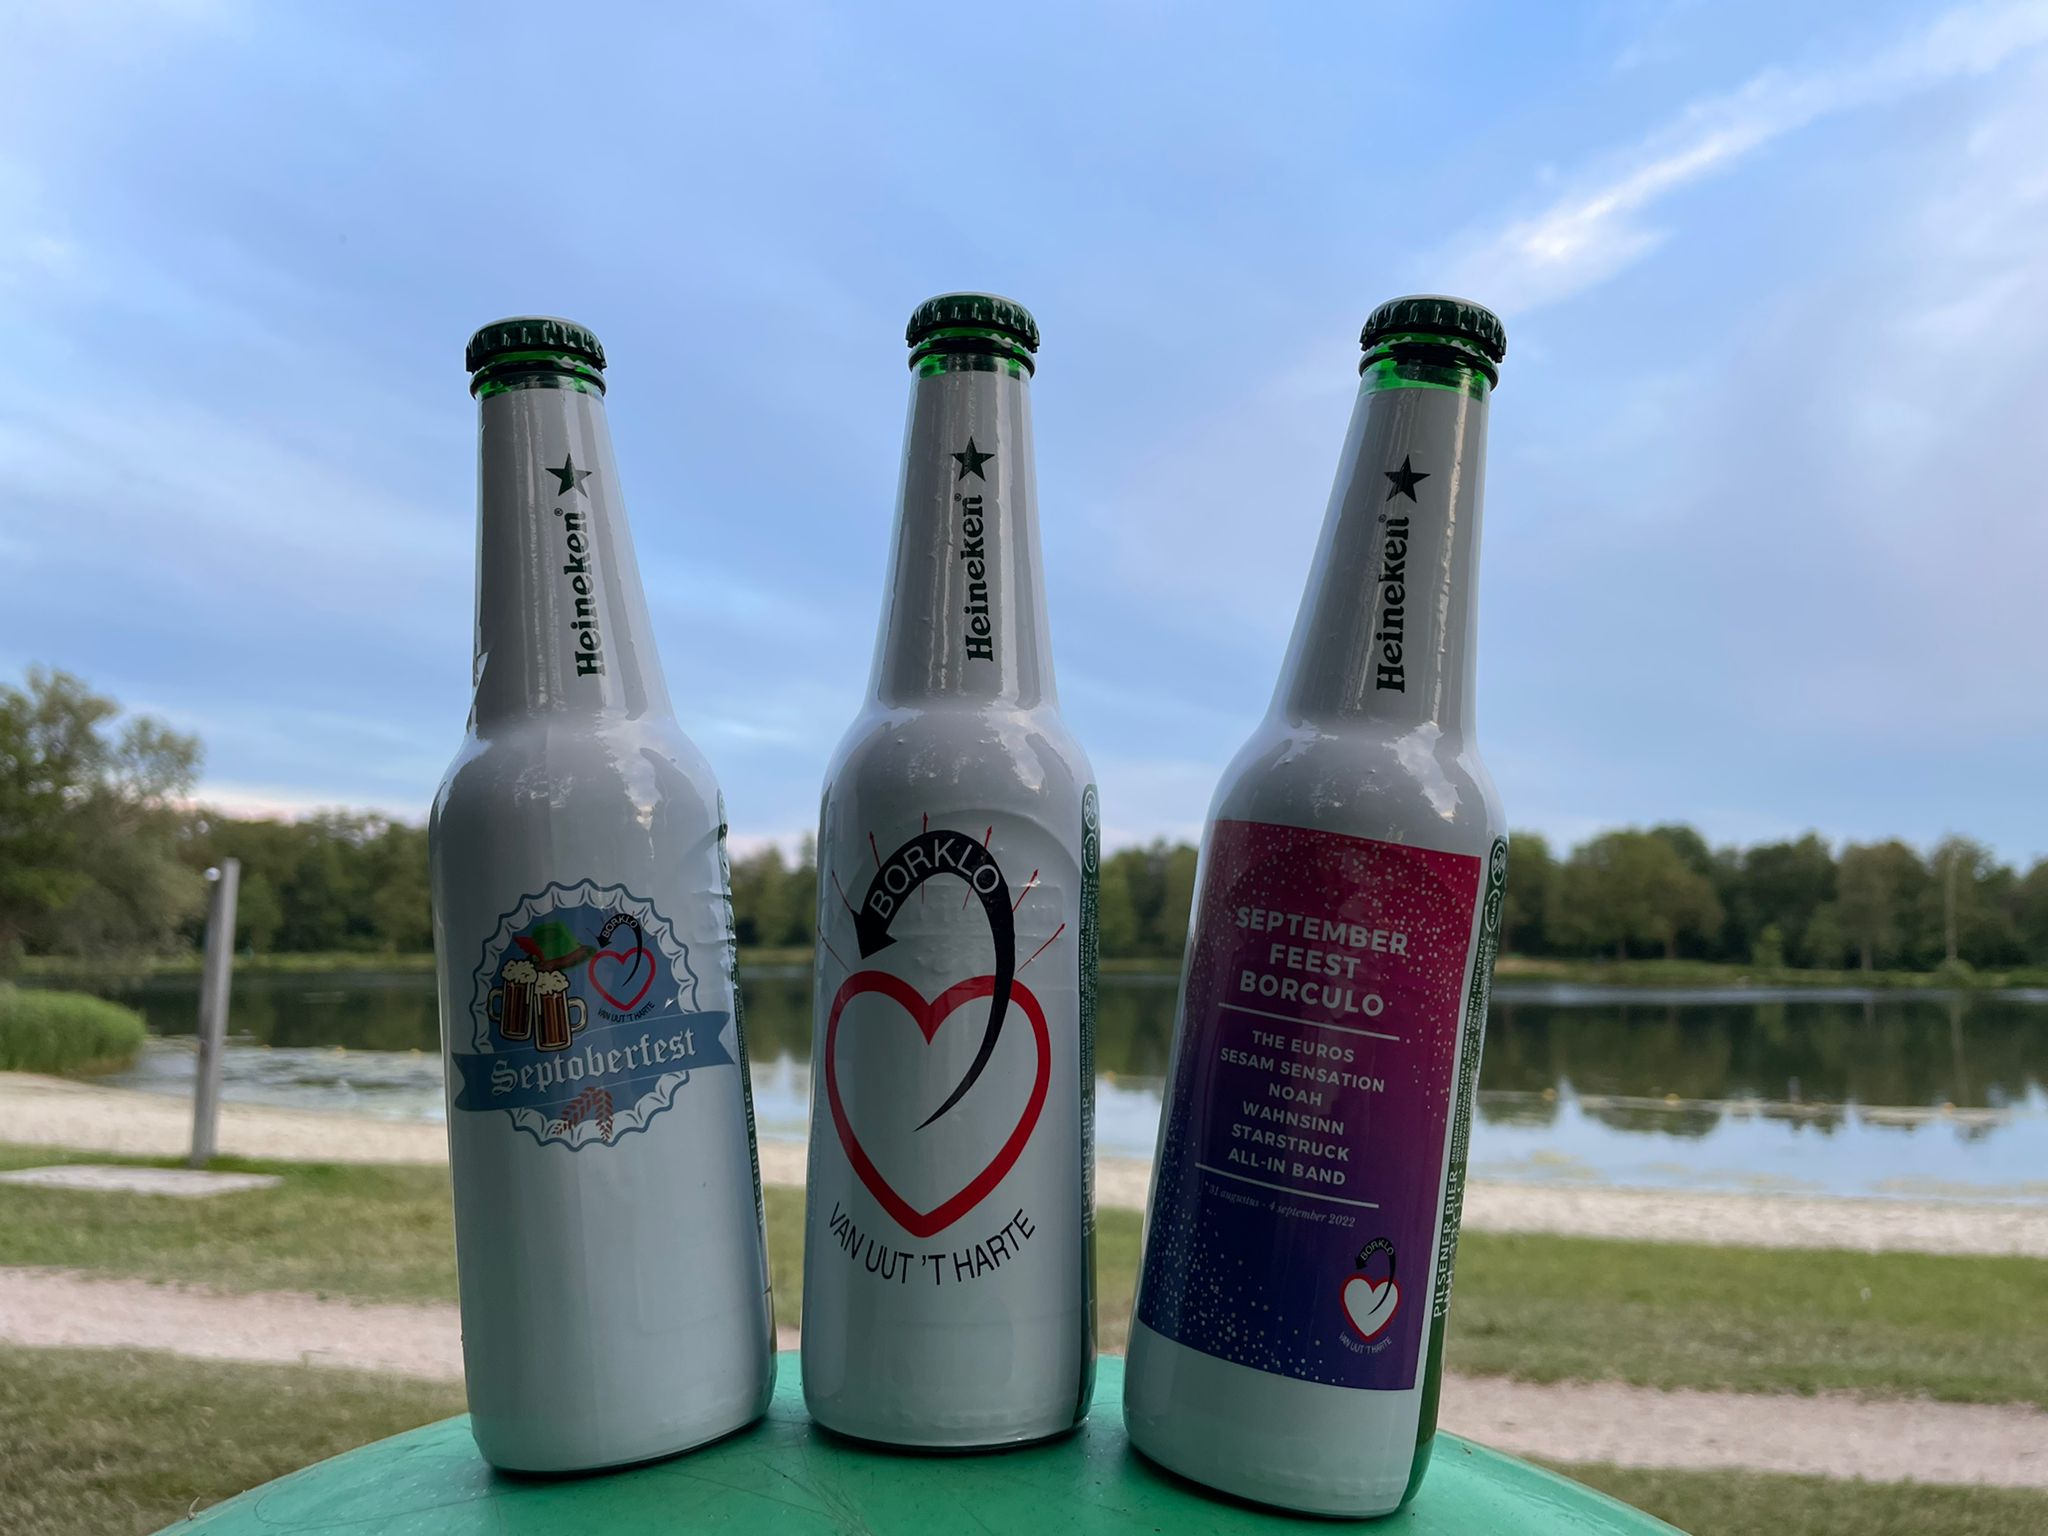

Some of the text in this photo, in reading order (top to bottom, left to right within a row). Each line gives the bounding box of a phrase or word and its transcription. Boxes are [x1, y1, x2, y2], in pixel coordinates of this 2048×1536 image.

[563, 510, 606, 677] Heineken
[960, 495, 994, 662] Heineken
[1376, 516, 1410, 693] Heineken
[870, 838, 999, 920] BORKLO
[602, 915, 638, 938] BORKLO
[1235, 906, 1409, 956] SEPTEMBER
[1269, 943, 1361, 979] FEEST
[598, 1008, 610, 1020] VAN
[611, 1014, 625, 1023] UUT
[635, 1001, 655, 1020] HARTE
[1240, 970, 1384, 1016] BORCULO
[491, 1028, 697, 1096] Septoberfest
[1252, 1030, 1355, 1063] THE EUROS
[1220, 1048, 1385, 1093] SESAM SENSATION
[1268, 1083, 1322, 1107] NOAH
[1243, 1101, 1345, 1136] WAHNSINN
[1231, 1123, 1350, 1162] STARSTRUCK
[1228, 1148, 1346, 1185] ALL-IN BAND
[1269, 1201, 1276, 1211] 4
[1277, 1206, 1327, 1223] september
[1328, 1214, 1356, 1228] 2022
[829, 1201, 1036, 1285] VAN UUT 'T HARTE
[1360, 1239, 1394, 1260] BORKLO
[1433, 1222, 1452, 1318] PILSENER
[1445, 1170, 1458, 1215] BIER
[1339, 1332, 1349, 1348] VAN
[1350, 1341, 1364, 1353] UUT
[1371, 1336, 1392, 1354] HARTE
